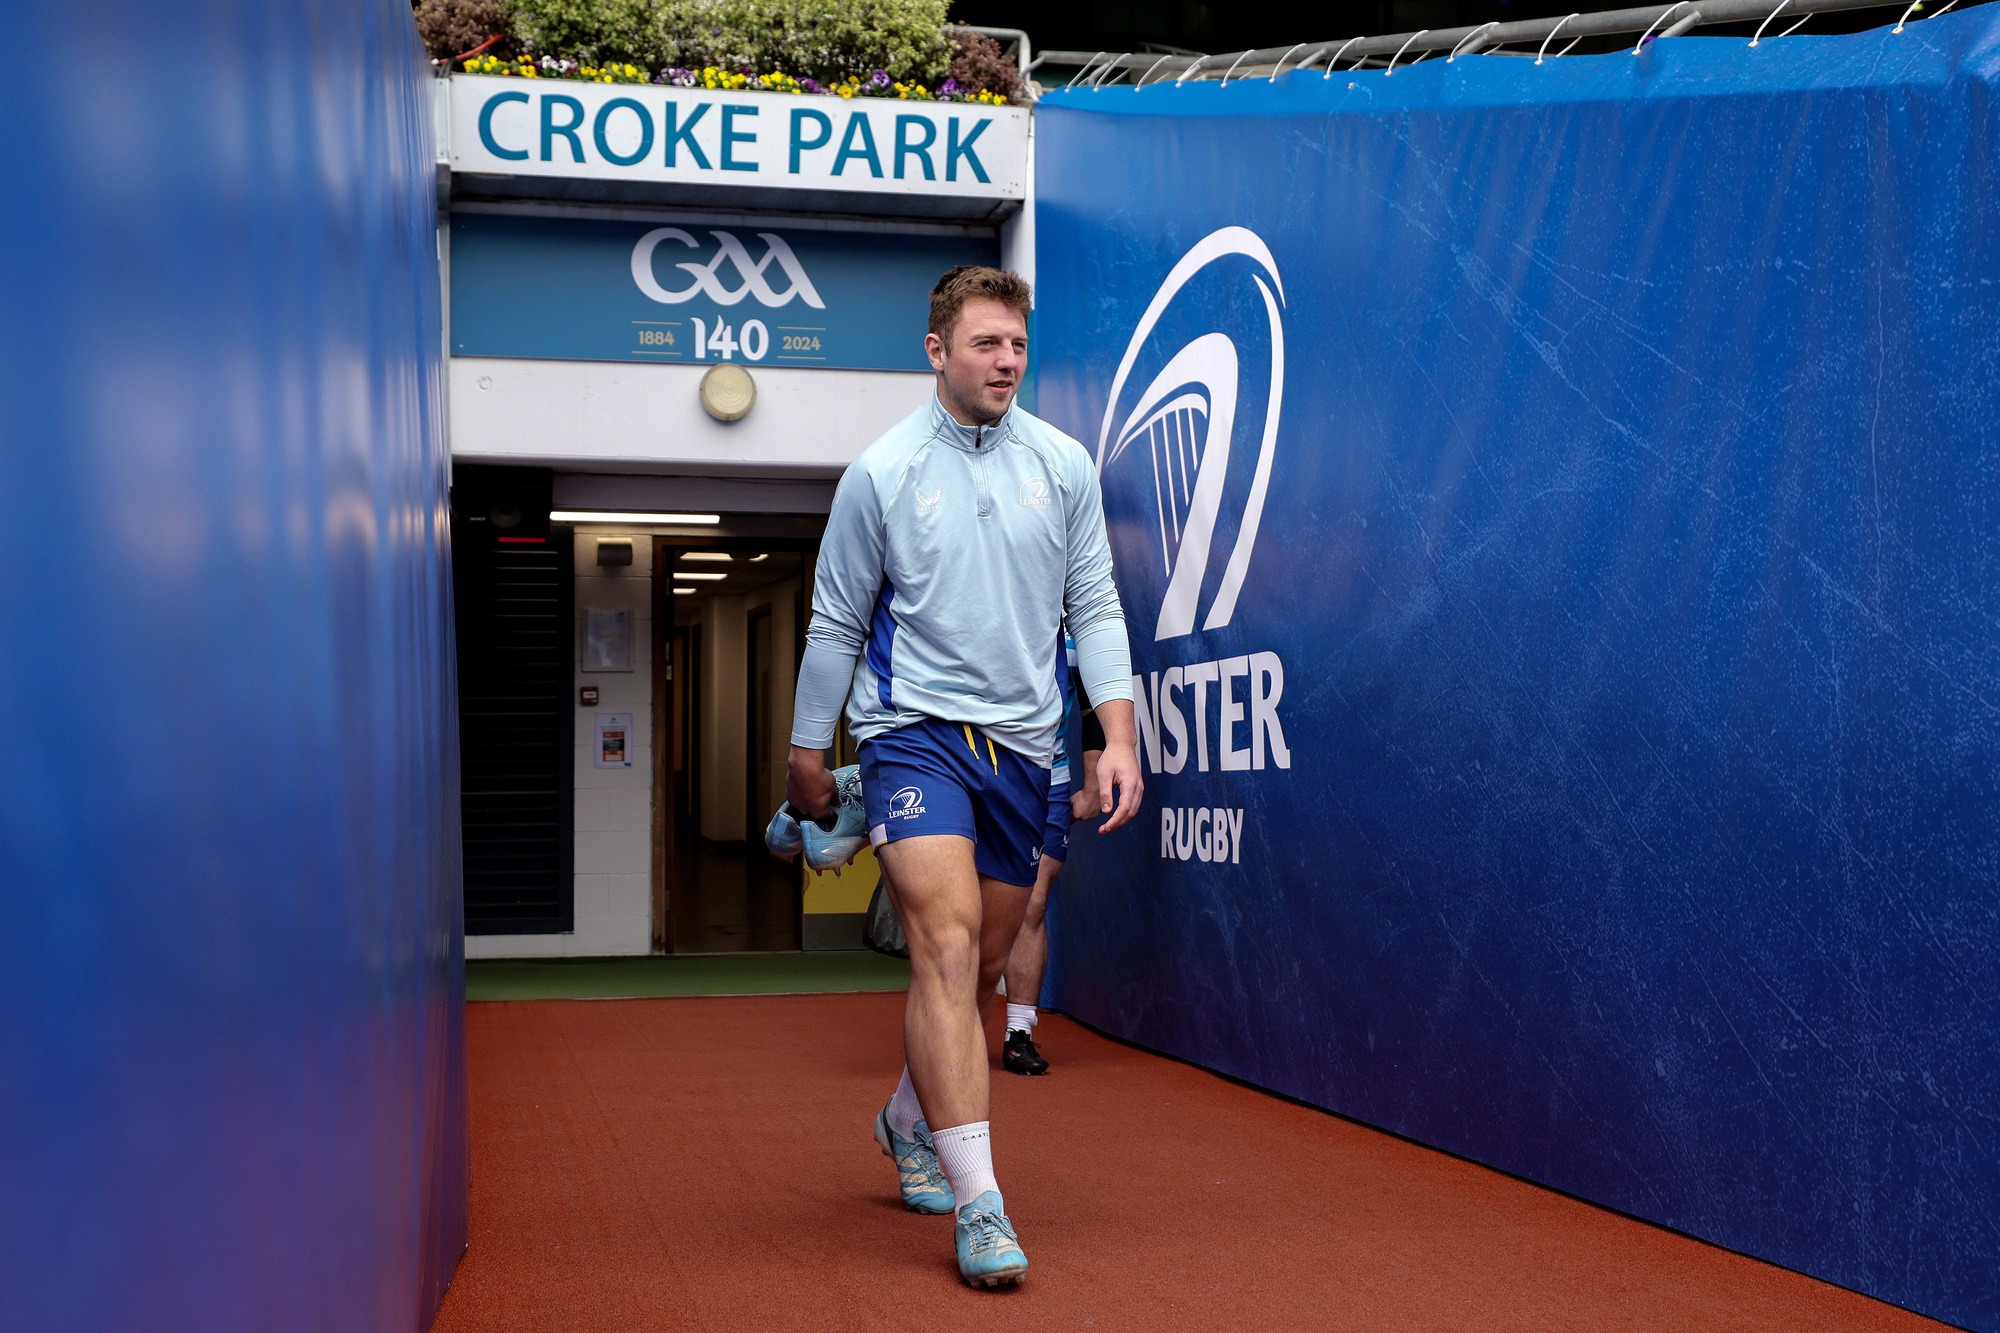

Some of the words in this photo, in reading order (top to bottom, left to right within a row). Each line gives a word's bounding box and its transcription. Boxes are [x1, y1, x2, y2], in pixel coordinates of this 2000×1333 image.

[477, 90, 760, 172] CROKE
[788, 107, 994, 184] PARK
[630, 226, 827, 310] GAA
[638, 330, 675, 346] 1884
[690, 314, 770, 361] 140
[782, 335, 822, 351] 2024
[1018, 497, 1053, 506] LEINSTER
[1132, 650, 1291, 775] NSTER
[888, 806, 927, 819] LEINSTER
[1160, 806, 1244, 864] RUGBY
